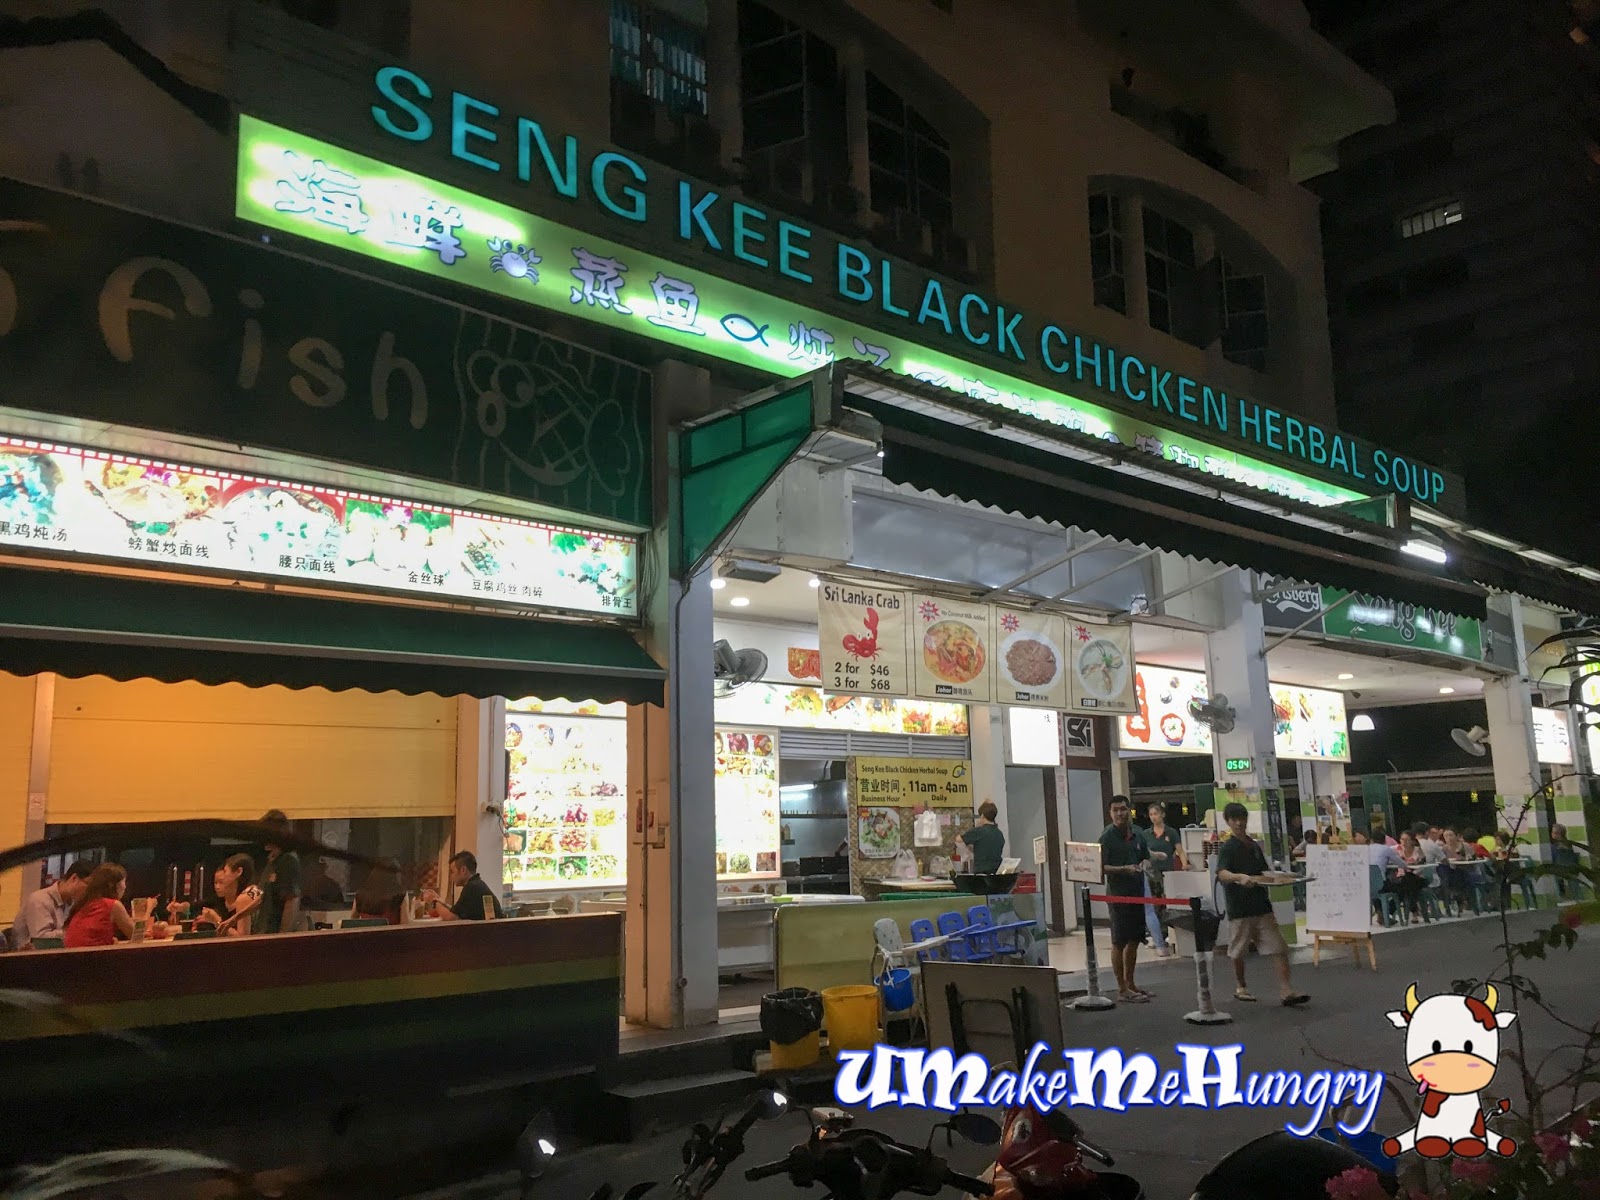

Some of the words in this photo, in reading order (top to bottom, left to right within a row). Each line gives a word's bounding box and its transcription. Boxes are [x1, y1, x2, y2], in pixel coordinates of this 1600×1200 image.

[371, 66, 648, 222] SENG
[679, 181, 813, 284] KEE
[838, 243, 1026, 361] BLACK
[1040, 325, 1229, 432] CHICKEN
[1240, 405, 1366, 479] HERBAL
[1374, 453, 1445, 503] SOUP
[570, 247, 706, 335] 蒸鱼
[408, 571, 445, 586] 金丝球
[602, 595, 633, 609] 排骨王
[824, 585, 839, 602] Sri
[842, 590, 873, 607] Lanka
[876, 592, 900, 610] Crab
[834, 662, 842, 673] 2
[845, 662, 860, 674] for
[870, 663, 890, 677] $46
[834, 676, 842, 688] 3
[845, 677, 860, 689] for
[870, 678, 891, 691] $68
[936, 686, 952, 694] Johor
[862, 765, 875, 774] Seng
[875, 765, 885, 773] Kee
[900, 766, 918, 774] Chicken
[936, 768, 948, 776] Soup
[908, 780, 937, 793] 11am
[946, 781, 968, 793] 4am
[862, 794, 886, 802] Business
[931, 794, 948, 802] Daily
